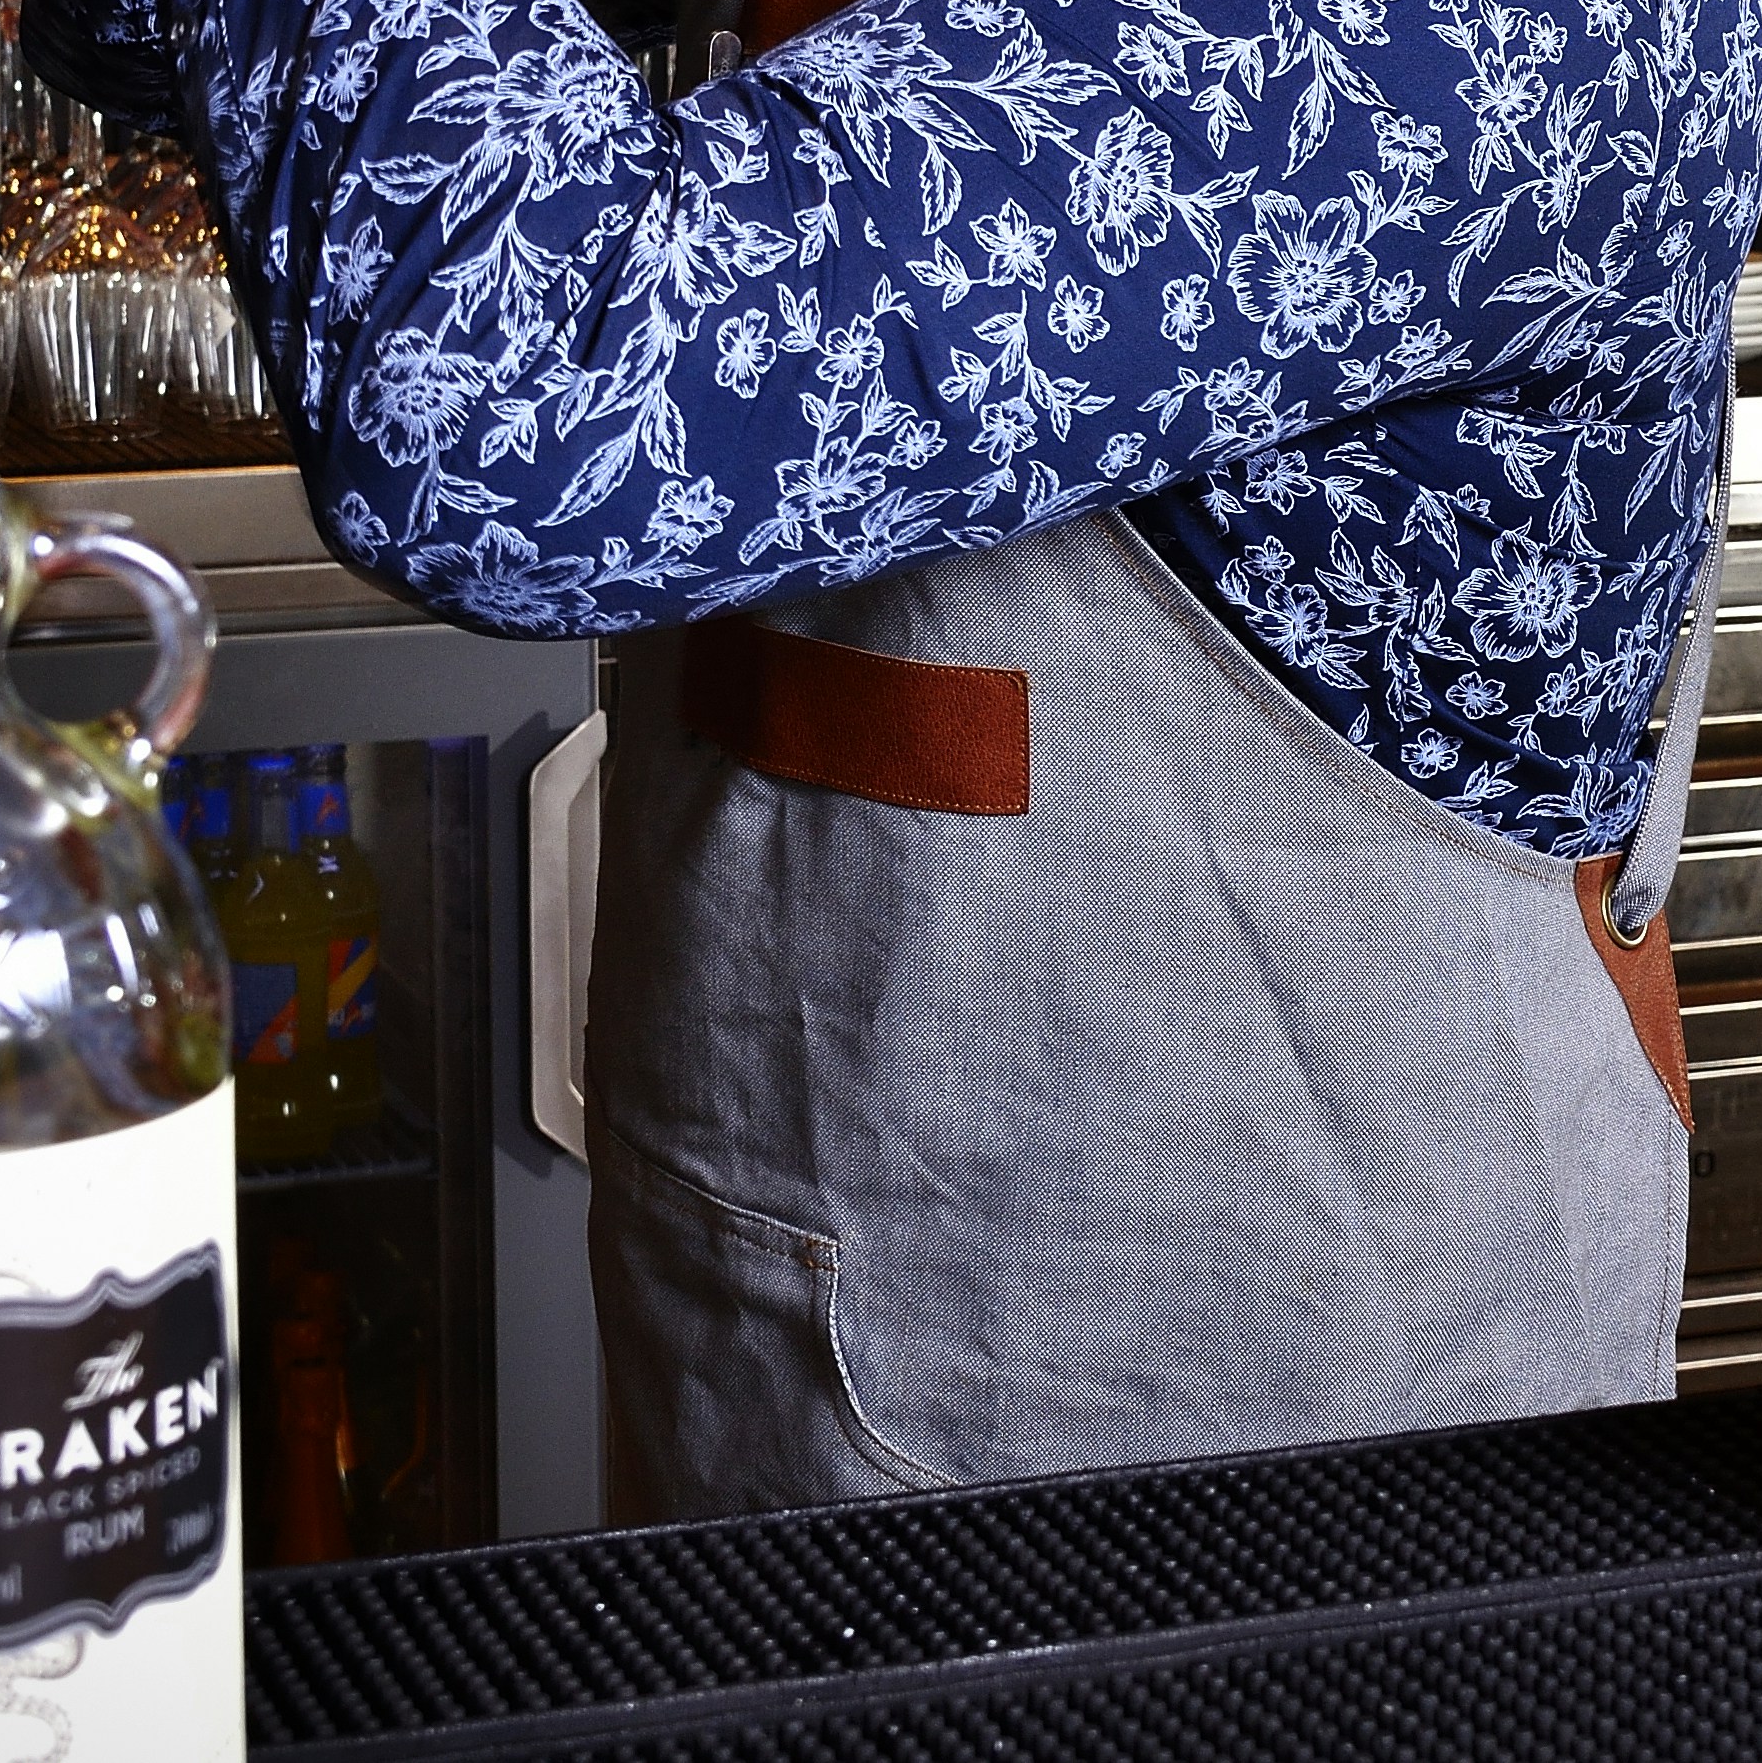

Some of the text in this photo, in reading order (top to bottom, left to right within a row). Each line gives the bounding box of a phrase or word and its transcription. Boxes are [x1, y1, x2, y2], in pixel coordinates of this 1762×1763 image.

[62, 1329, 145, 1413] The
[105, 1444, 202, 1505] SPICED
[62, 1503, 146, 1562] RUM
